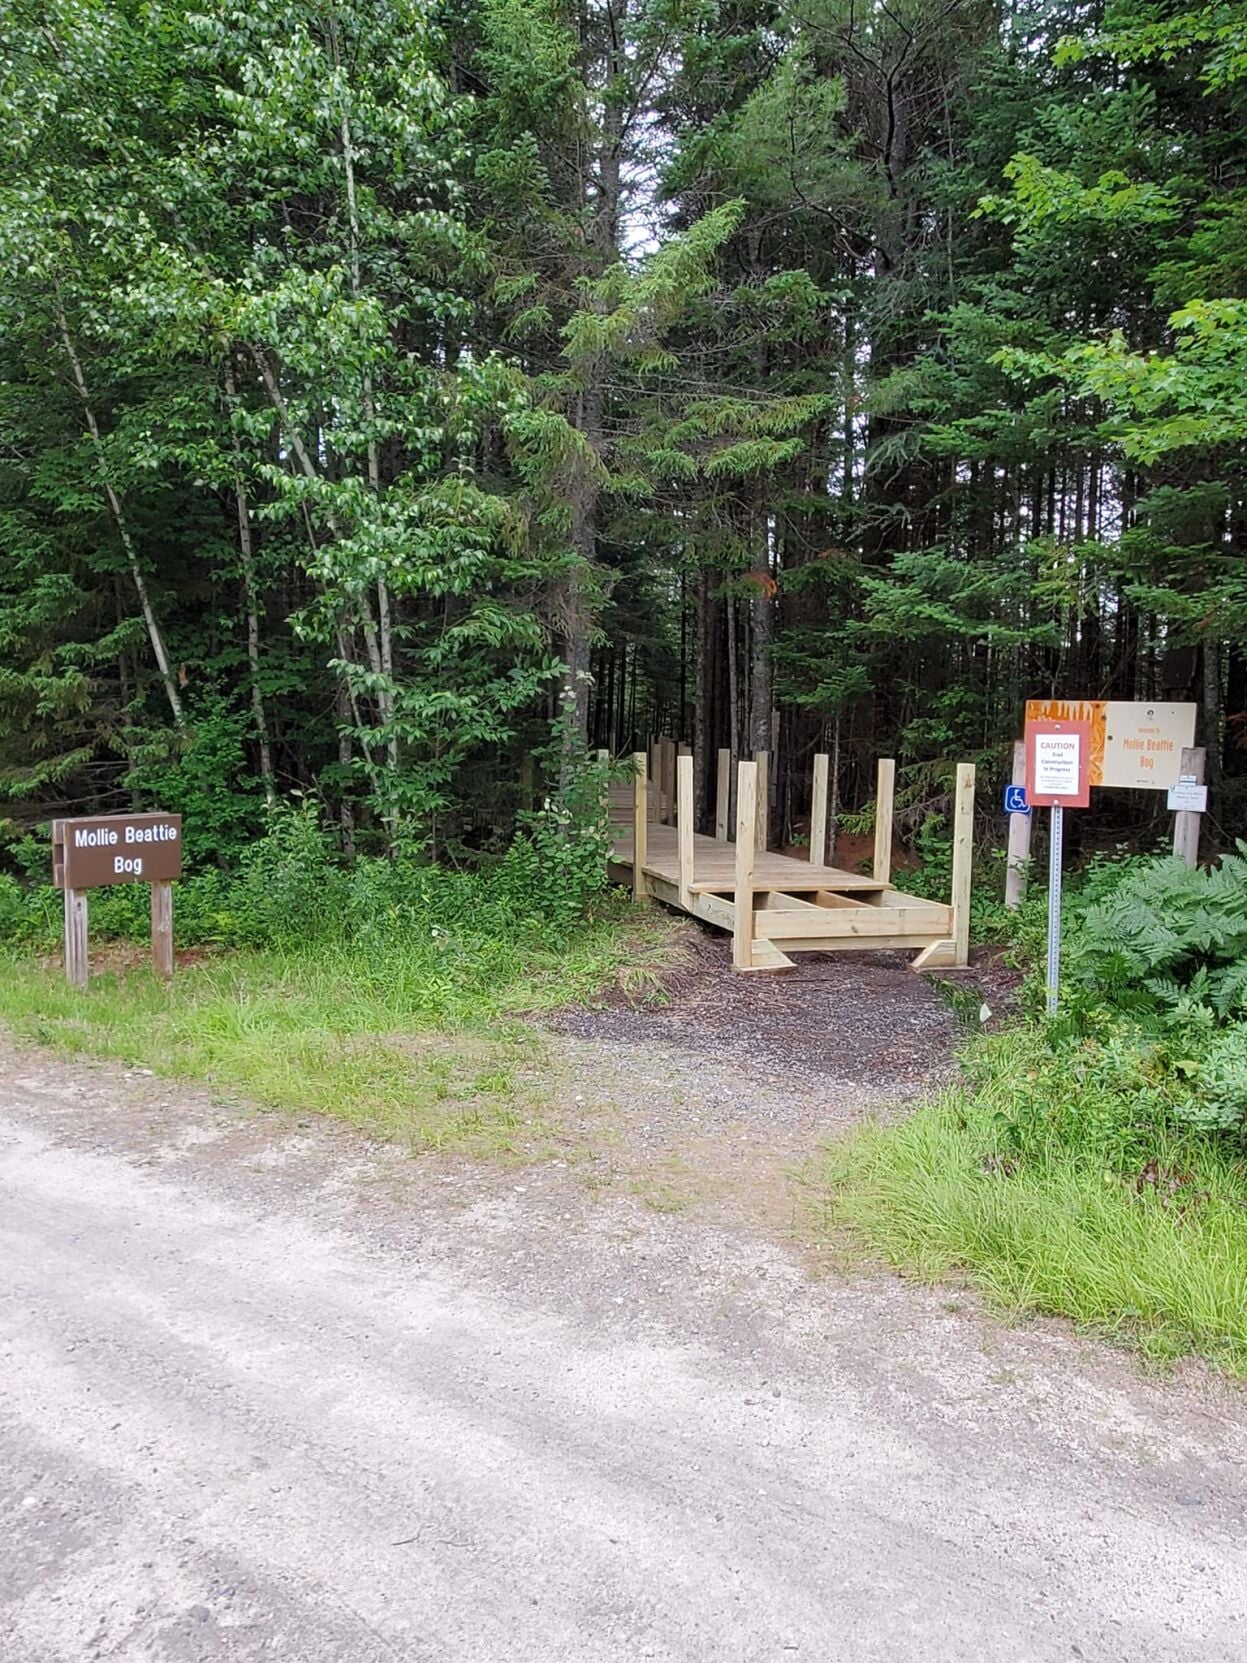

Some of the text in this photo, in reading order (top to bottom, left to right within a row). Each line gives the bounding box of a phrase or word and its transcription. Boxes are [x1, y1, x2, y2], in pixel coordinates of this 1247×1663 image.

[1040, 742, 1075, 750] CAUTION
[1123, 738, 1174, 752] Mollie Beattie
[1140, 756, 1153, 769] Bog
[75, 825, 177, 848] Mollie Beattie
[114, 856, 142, 875] Bog
